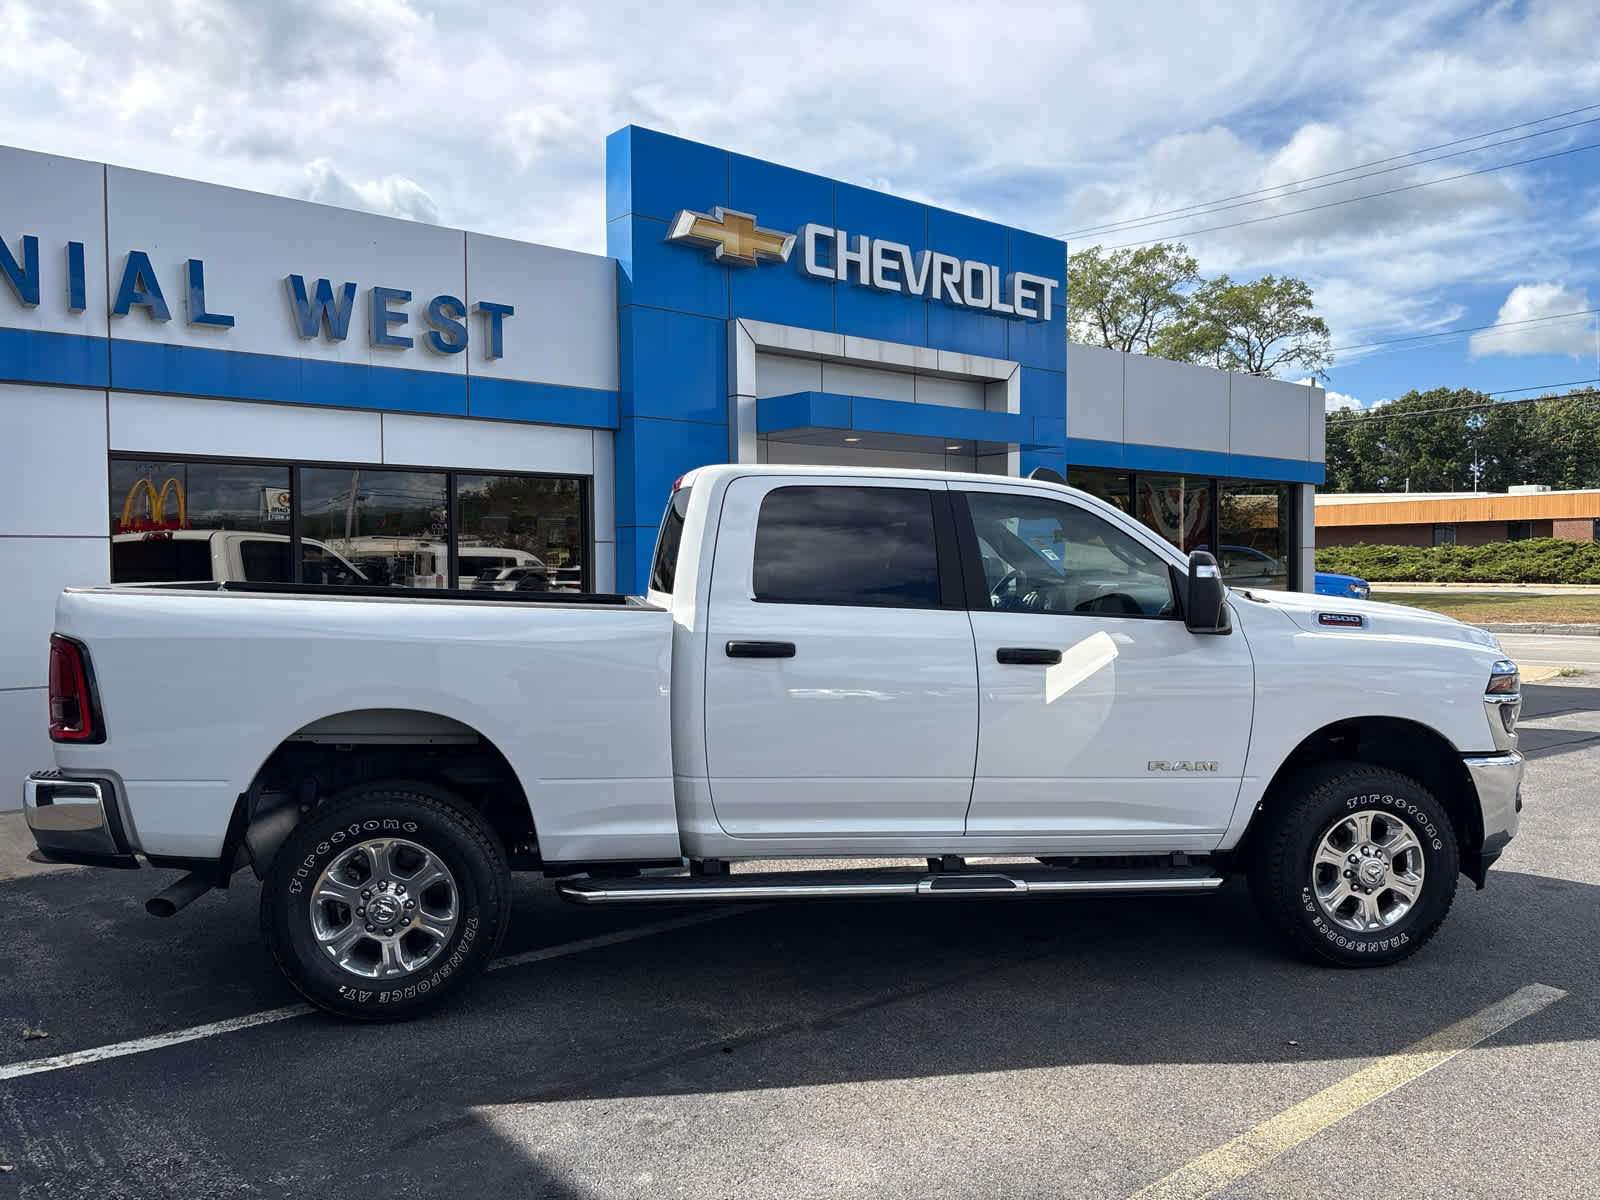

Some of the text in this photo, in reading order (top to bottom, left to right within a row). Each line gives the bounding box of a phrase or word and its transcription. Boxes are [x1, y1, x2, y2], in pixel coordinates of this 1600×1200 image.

[0, 233, 515, 361] NIAL WEST
[801, 223, 1059, 321] CHEVROLET
[1321, 615, 1361, 623] 2500
[1147, 760, 1219, 772] RAM
[378, 916, 479, 1003] TRANSFORCE
[1312, 916, 1410, 952] TRANSFORCE
